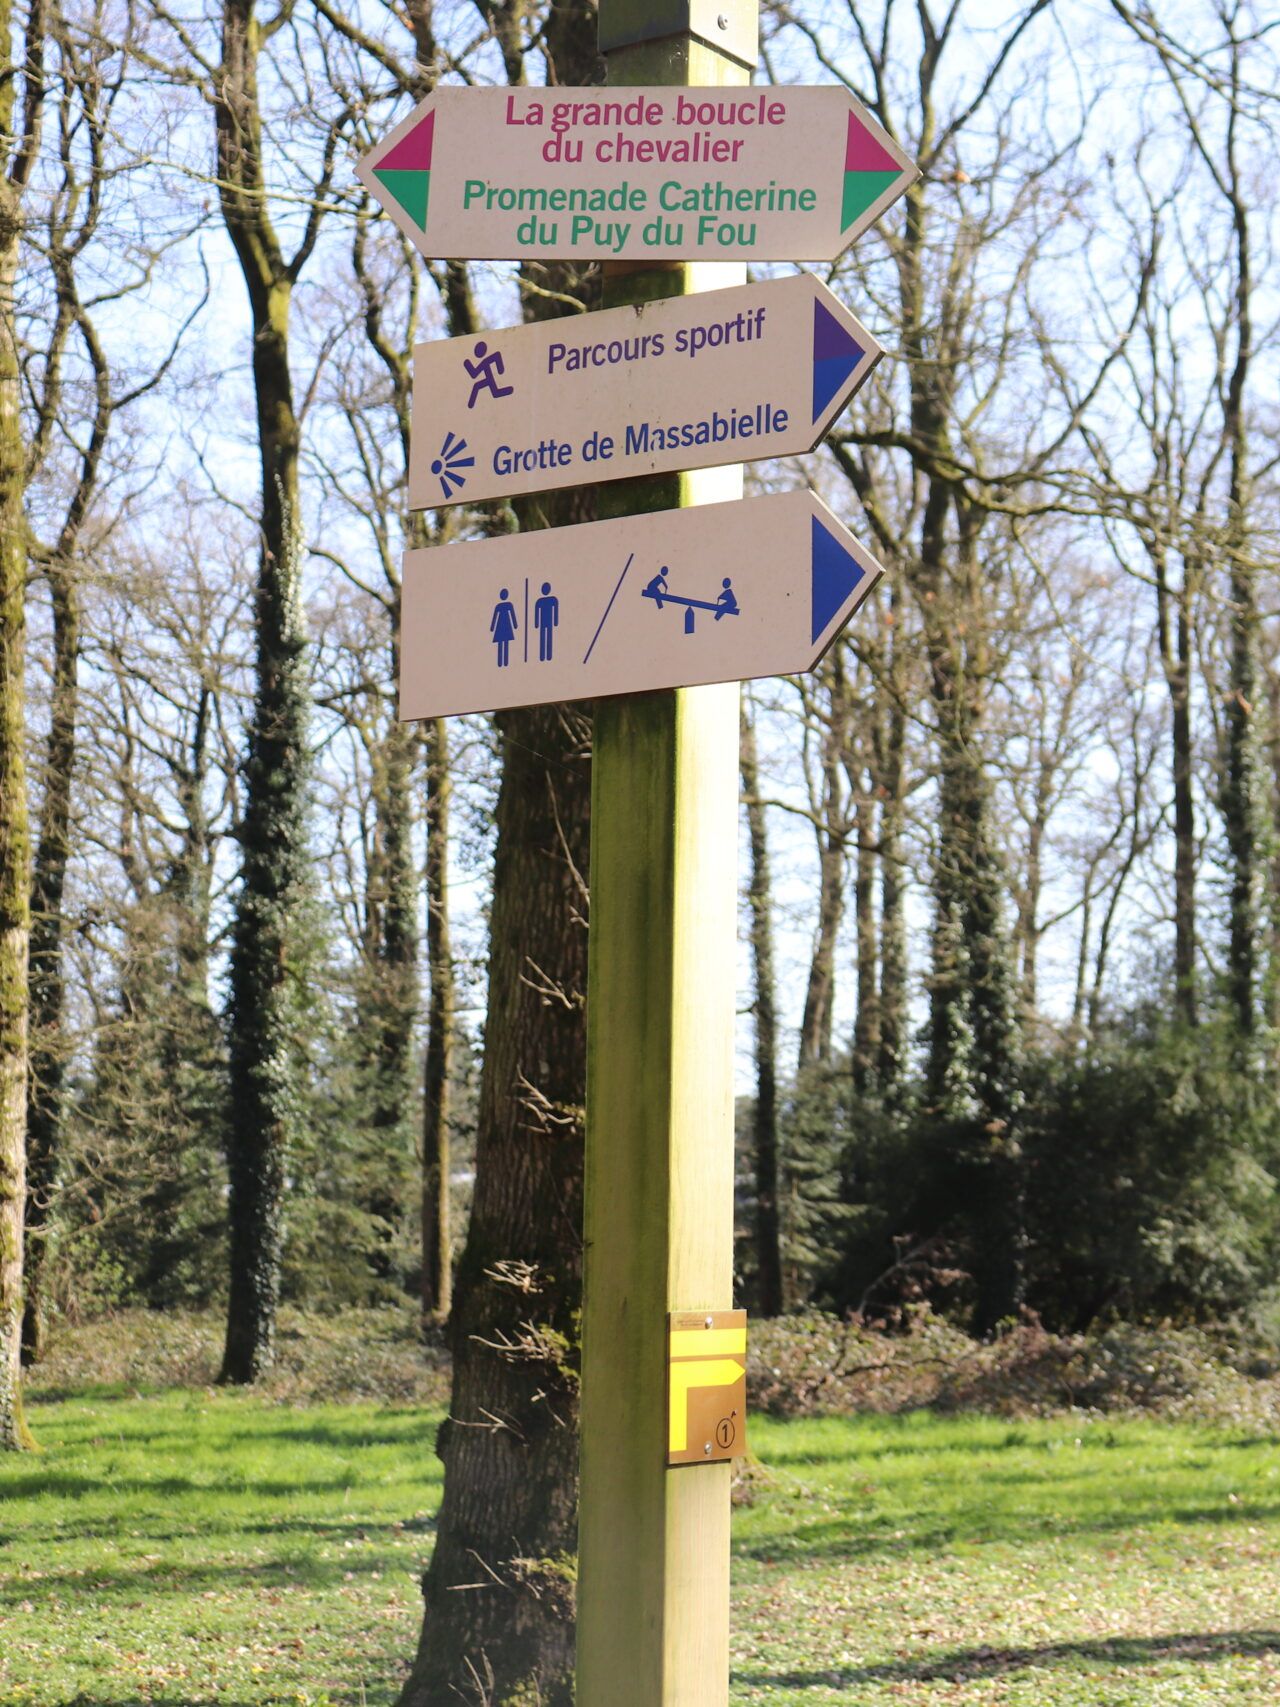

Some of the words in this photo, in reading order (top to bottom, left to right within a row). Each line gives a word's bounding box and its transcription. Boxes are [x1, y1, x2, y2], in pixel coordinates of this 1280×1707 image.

[506, 96, 544, 126] La
[551, 96, 663, 133] grande
[677, 95, 786, 126] boucle
[543, 131, 583, 162] du
[596, 131, 744, 162] chevalier
[463, 180, 647, 210] Promenade
[660, 181, 817, 211] Catherine
[517, 216, 557, 245] du
[571, 216, 631, 252] Puy
[643, 216, 683, 245] du
[697, 216, 757, 246] Fou
[548, 333, 664, 374] Parcours
[675, 307, 766, 357] sportif
[493, 439, 571, 476] Grotte
[582, 431, 614, 462] de
[625, 404, 789, 455] Massabielle
